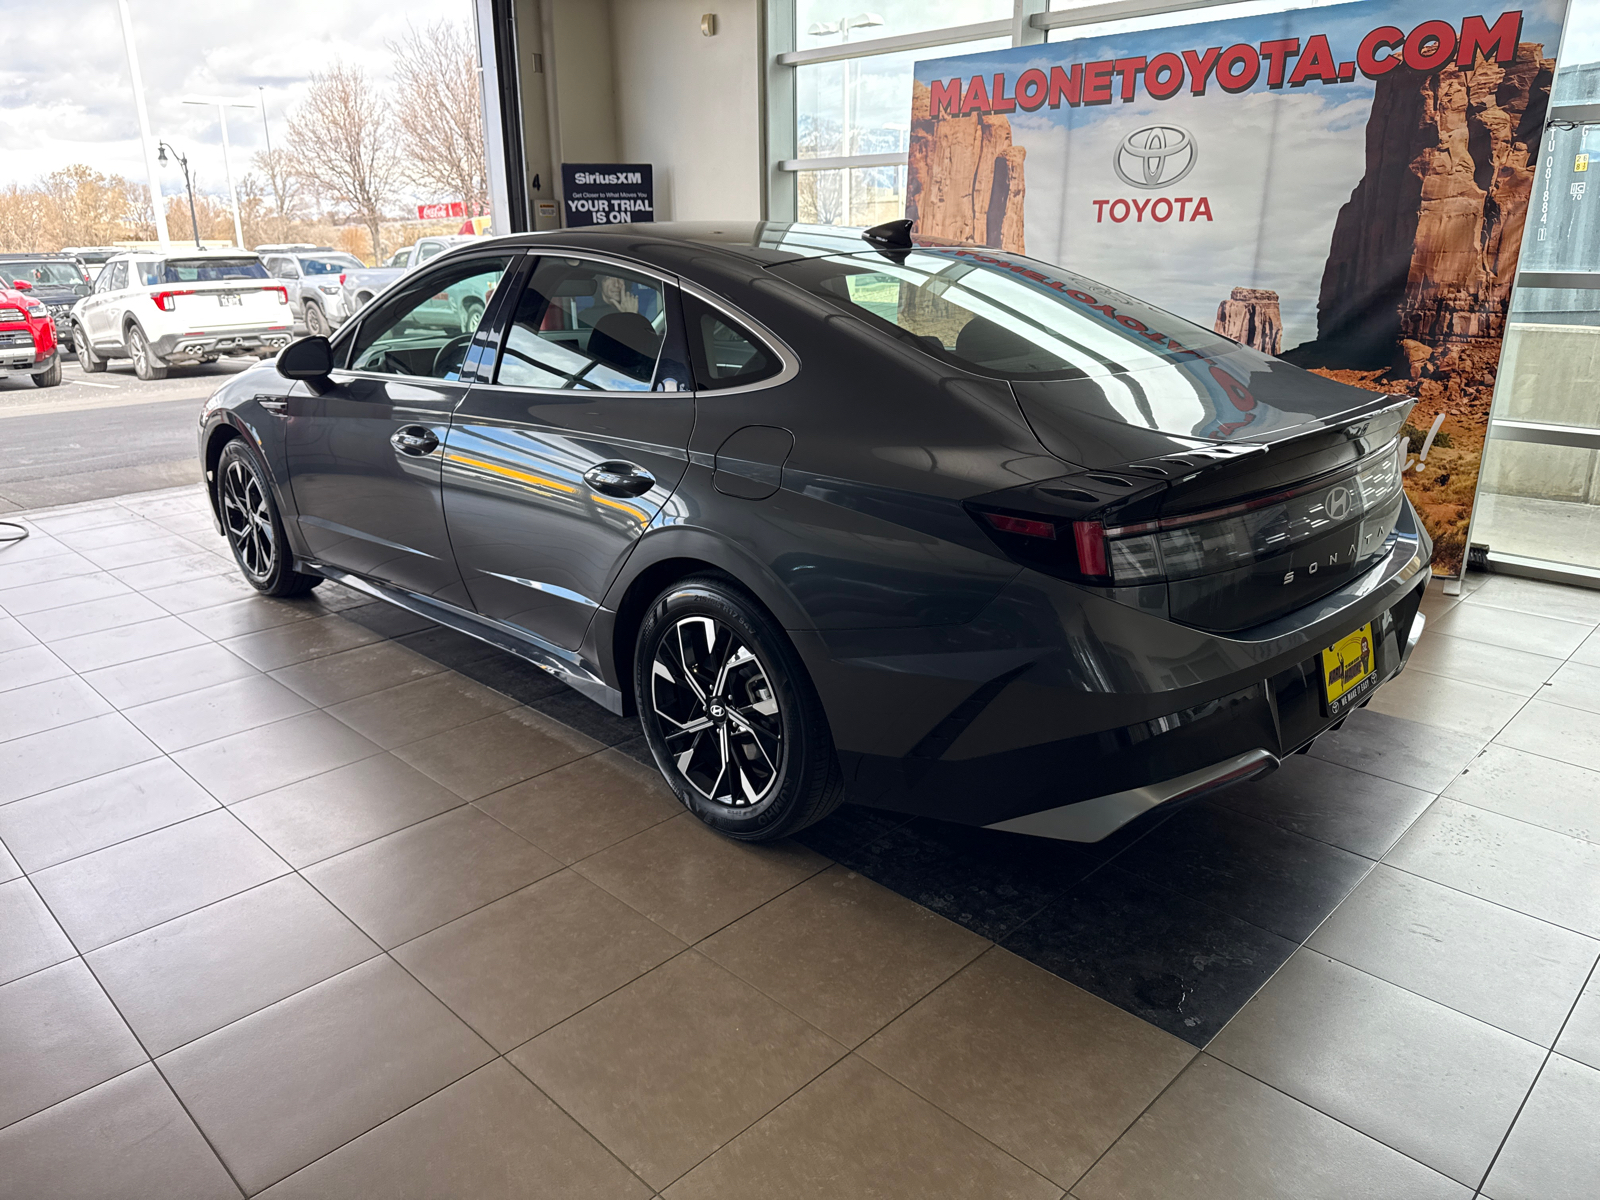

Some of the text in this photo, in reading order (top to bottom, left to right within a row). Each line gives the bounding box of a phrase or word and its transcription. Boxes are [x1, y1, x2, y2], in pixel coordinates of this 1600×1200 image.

[929, 10, 1524, 119] MALONETOYOTA.COM
[532, 173, 541, 191] 4
[574, 172, 642, 185] SiriusXM
[1540, 156, 1553, 224] 081884
[568, 200, 609, 212] YOUR
[611, 200, 653, 212] TRIAL
[1092, 197, 1214, 223] TOYOTA
[592, 212, 631, 224] IS ON
[1283, 526, 1385, 585] SONATA
[1347, 688, 1358, 702] MAKE
